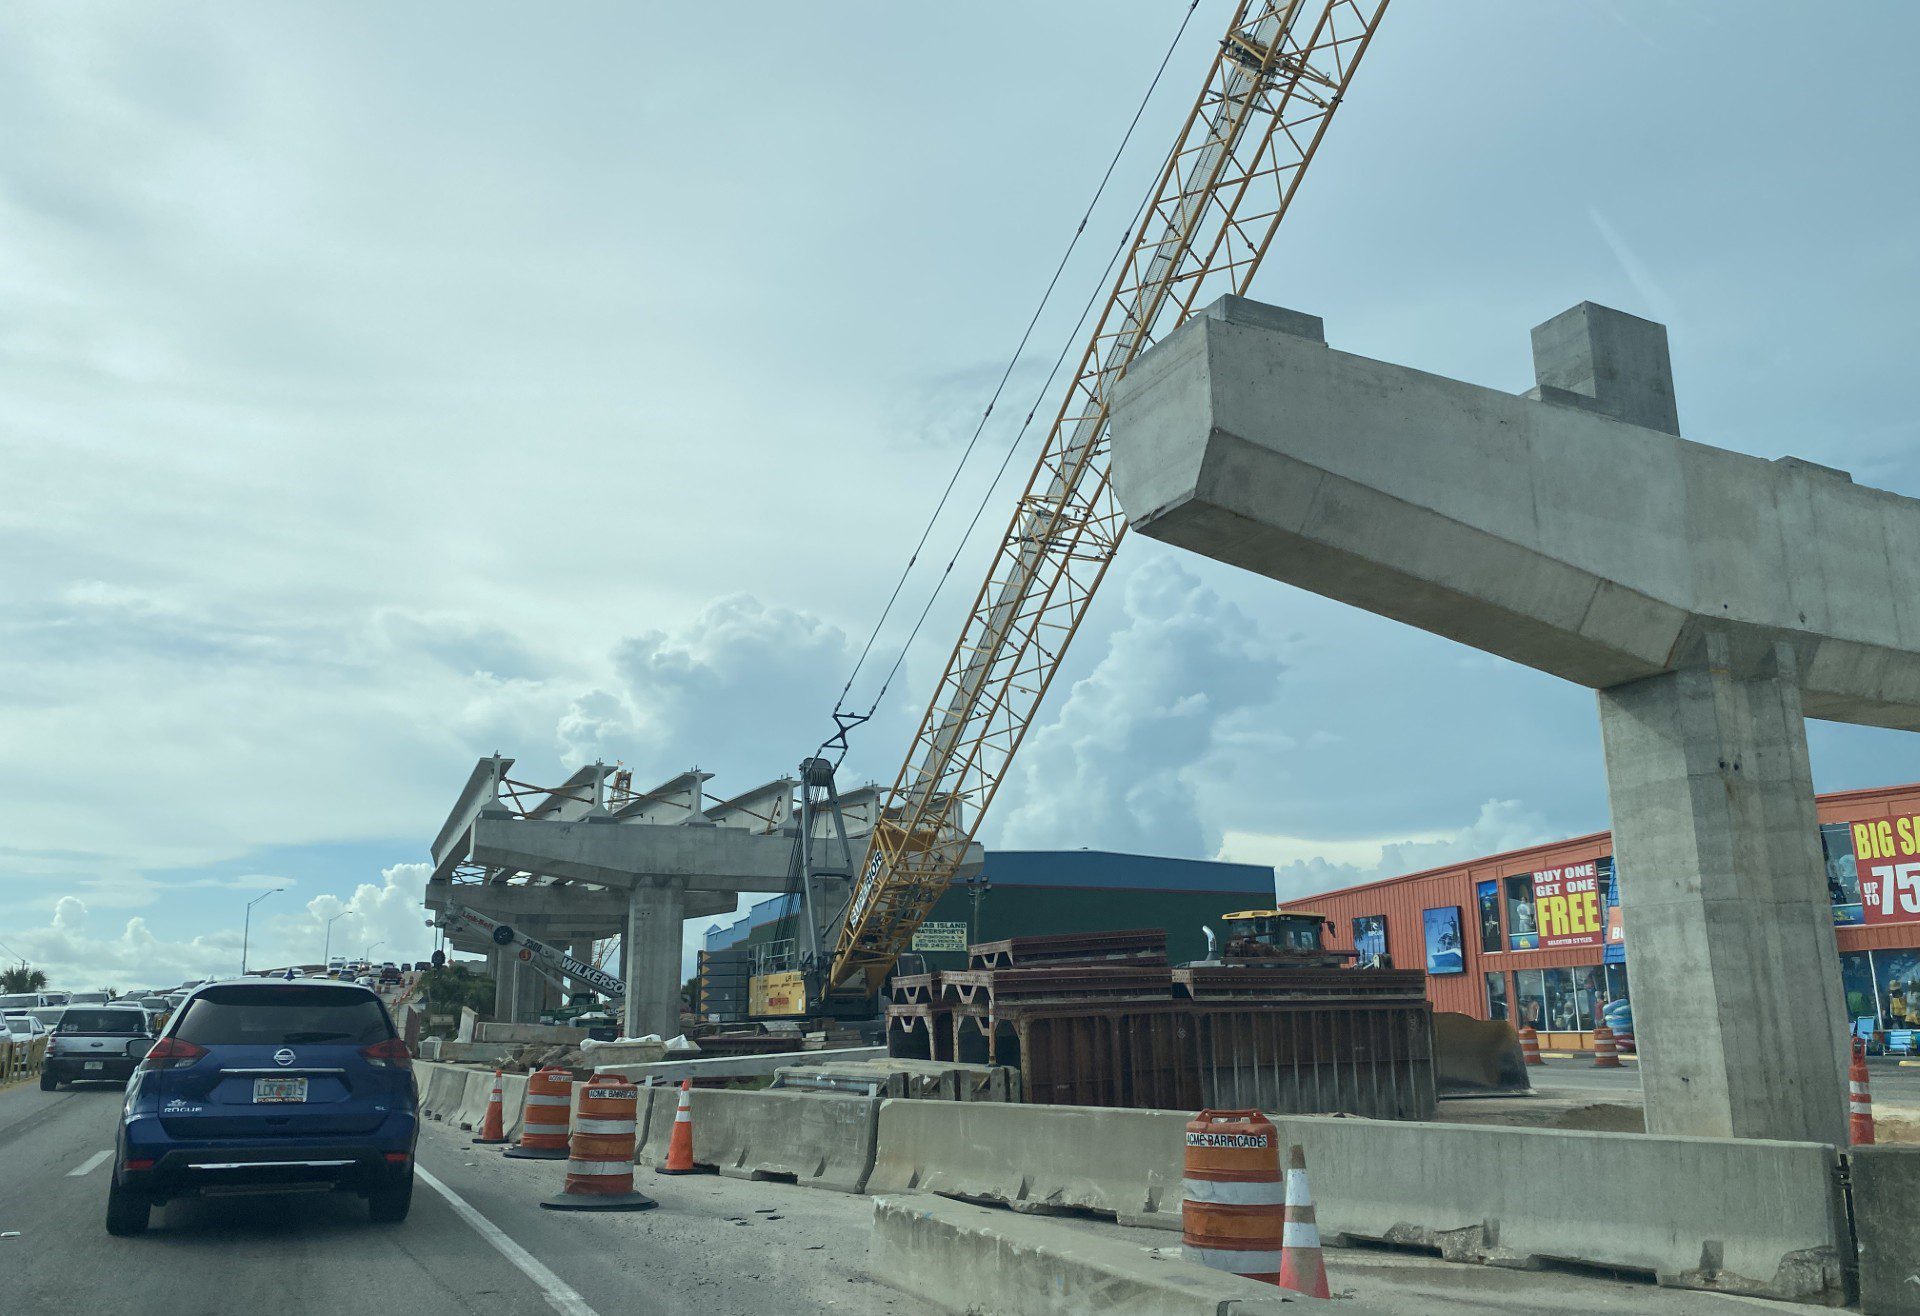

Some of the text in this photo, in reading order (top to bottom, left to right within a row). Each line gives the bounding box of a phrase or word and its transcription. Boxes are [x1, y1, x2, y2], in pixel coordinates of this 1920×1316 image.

[1853, 820, 1896, 860] BIG
[1533, 864, 1594, 884] BUY ONE
[849, 851, 882, 928] SUPERIOR
[1535, 878, 1596, 897] GET ONE
[1863, 881, 1879, 895] UP
[1871, 861, 1920, 916] 75
[1864, 893, 1880, 906] TO
[1536, 891, 1600, 937] FREE
[559, 955, 627, 996] WILKERSO
[590, 1089, 607, 1098] ACME
[1187, 1133, 1267, 1148] ACME BARRICADES
